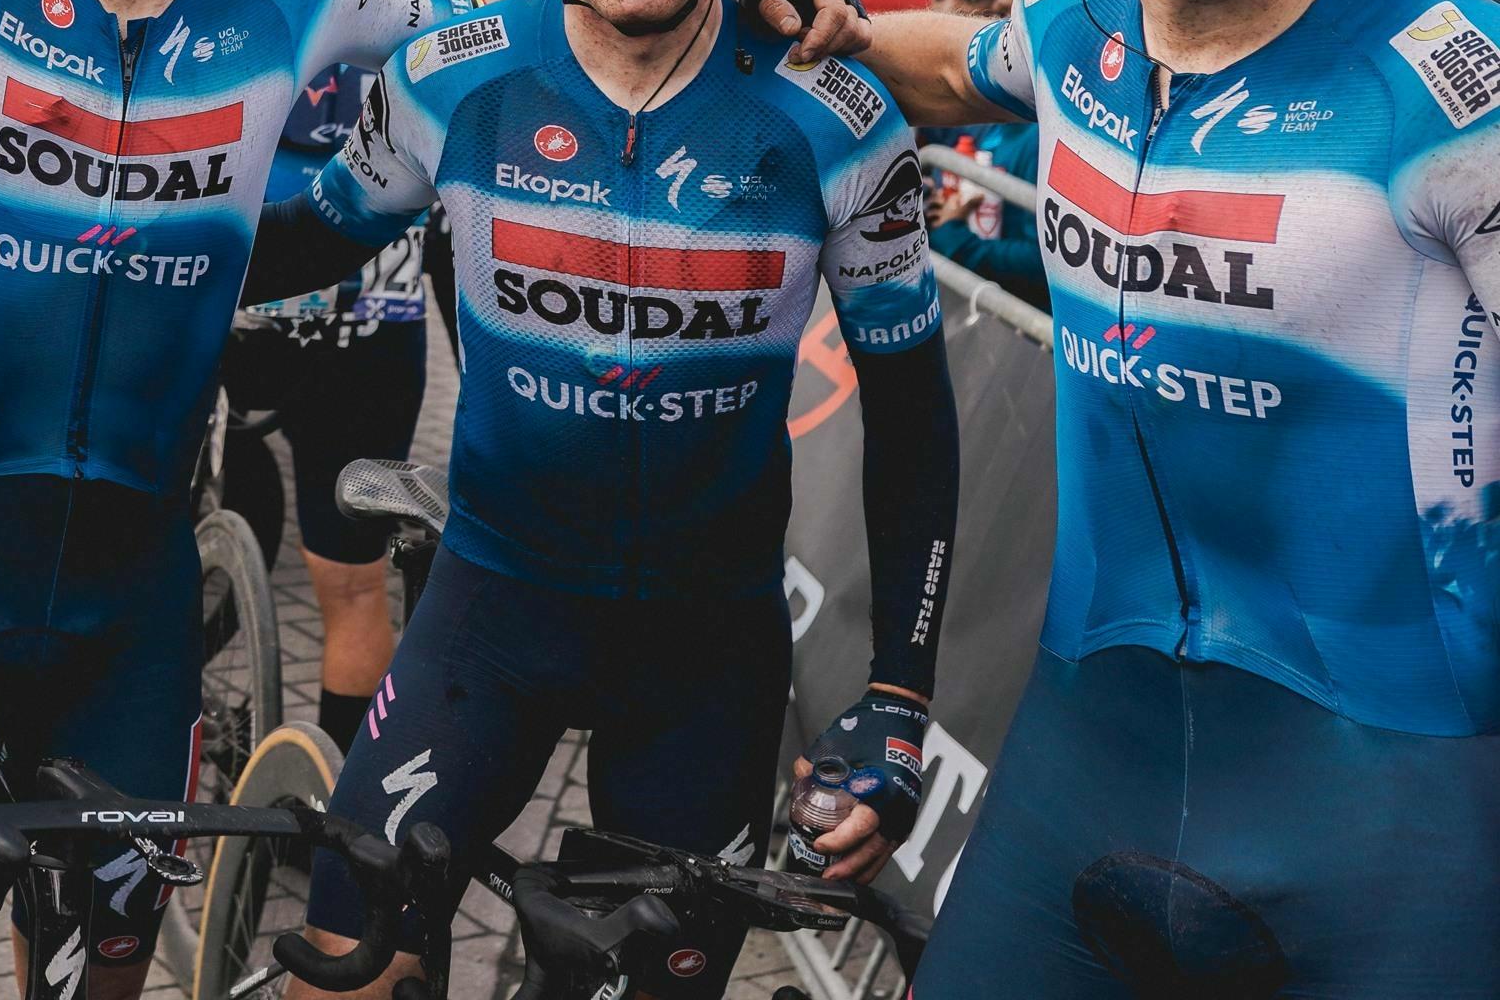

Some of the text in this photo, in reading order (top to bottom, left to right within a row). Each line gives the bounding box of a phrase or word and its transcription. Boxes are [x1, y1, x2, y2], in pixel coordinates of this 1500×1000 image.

[218, 28, 236, 40] UCI
[219, 29, 250, 49] WORLD
[437, 18, 498, 41] SAFETY
[437, 28, 503, 56] JOGGER
[220, 40, 244, 56] TEAM
[442, 52, 467, 64] SHOES
[475, 42, 505, 56] APPAREL
[824, 58, 884, 112] SAFETY
[1418, 59, 1437, 82] SHOES
[1438, 87, 1465, 123] APPAREL
[1430, 41, 1491, 114] JOGGER
[816, 70, 874, 128] JOGGER
[1061, 63, 1138, 152] Ekopak
[1288, 101, 1305, 112] UCI
[1280, 119, 1318, 134] TEAM
[1284, 110, 1334, 123] WORLD
[495, 163, 612, 207] Ekopak
[1044, 196, 1274, 310] SOUDAL
[493, 268, 772, 340] SOUDAL
[910, 539, 946, 646] NANO FLEX
[81, 810, 186, 824] roval
